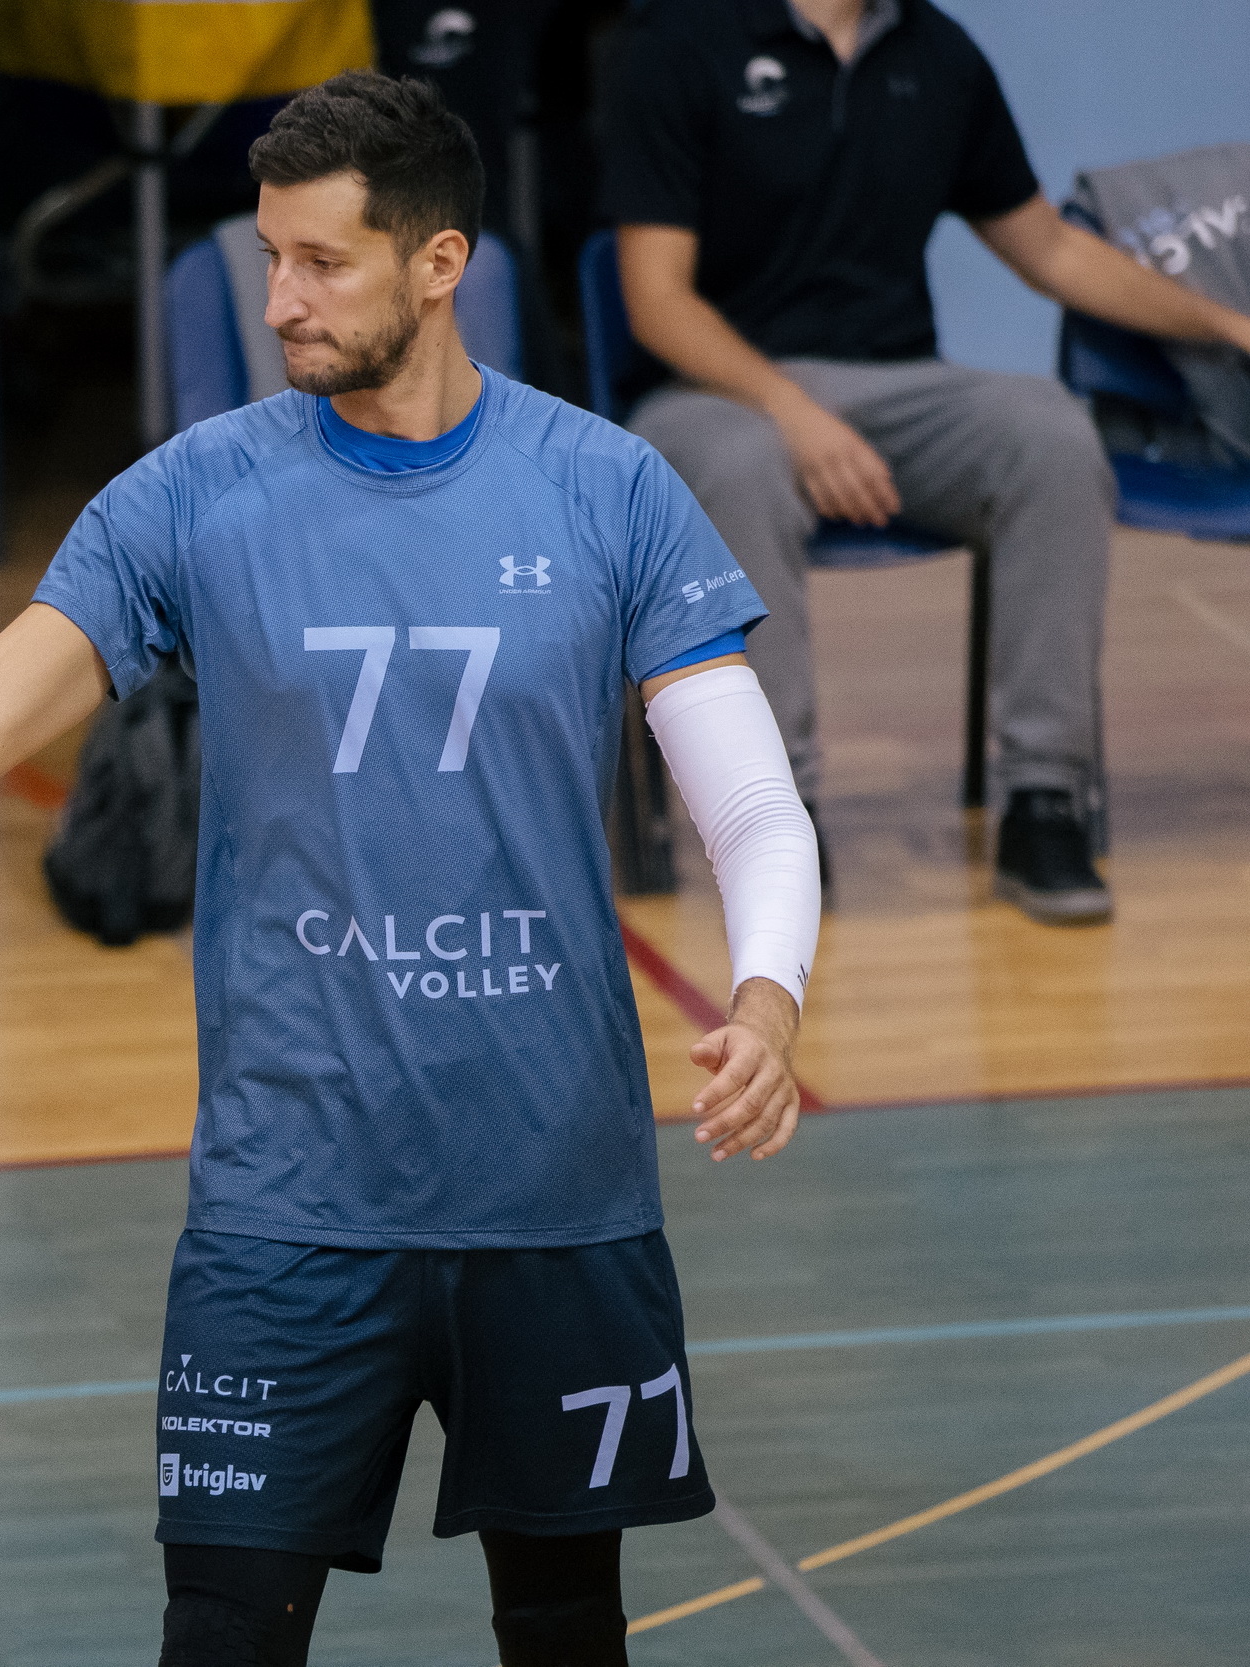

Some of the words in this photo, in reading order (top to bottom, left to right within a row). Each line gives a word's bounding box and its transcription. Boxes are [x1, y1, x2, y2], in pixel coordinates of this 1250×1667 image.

[705, 576, 725, 592] Avto
[723, 568, 746, 584] Cera
[303, 626, 501, 774] 77
[295, 908, 547, 962] CALCIT
[386, 962, 562, 1000] VOLLEY
[165, 1369, 278, 1401] CALCIT
[161, 1416, 272, 1438] KOLEKTOR
[560, 1362, 690, 1489] 77
[182, 1462, 267, 1496] triglav
